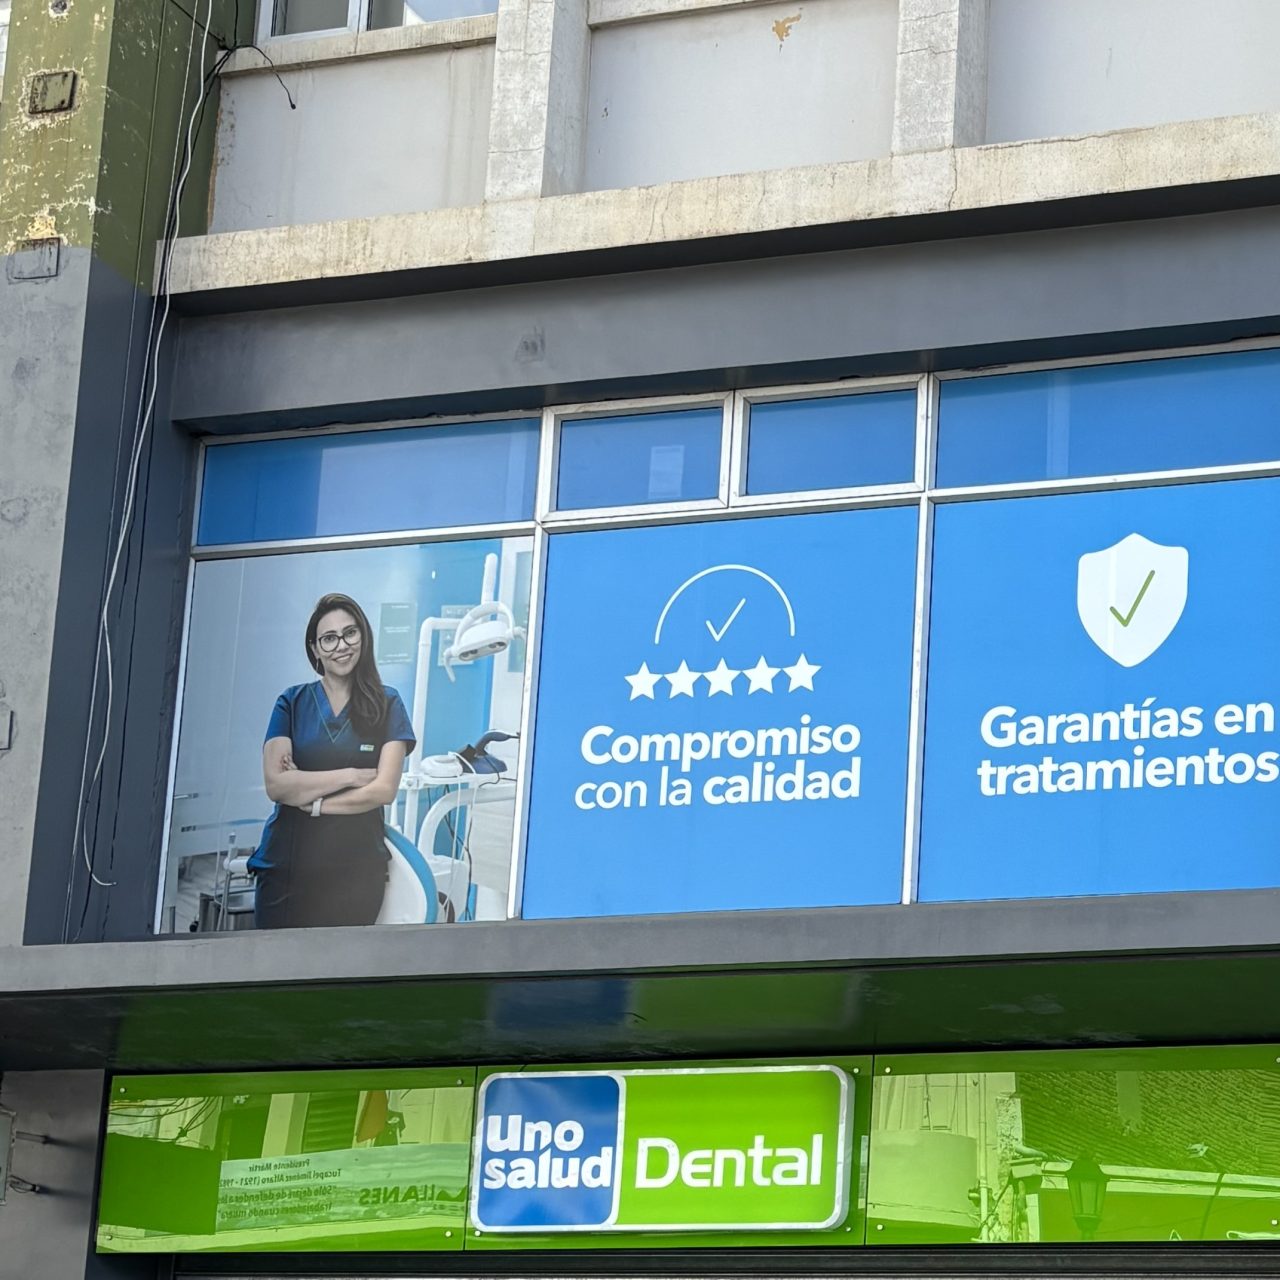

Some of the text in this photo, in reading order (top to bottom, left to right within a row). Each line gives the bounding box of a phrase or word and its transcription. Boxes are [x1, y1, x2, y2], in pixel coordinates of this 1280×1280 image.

[580, 714, 861, 772] Compromiso
[980, 697, 1275, 748] Garantías en
[574, 756, 861, 810] con la calidad
[977, 745, 1280, 797] tratamientos
[486, 1114, 585, 1152] Uno
[483, 1146, 613, 1190] salud
[635, 1133, 823, 1189] Dental
